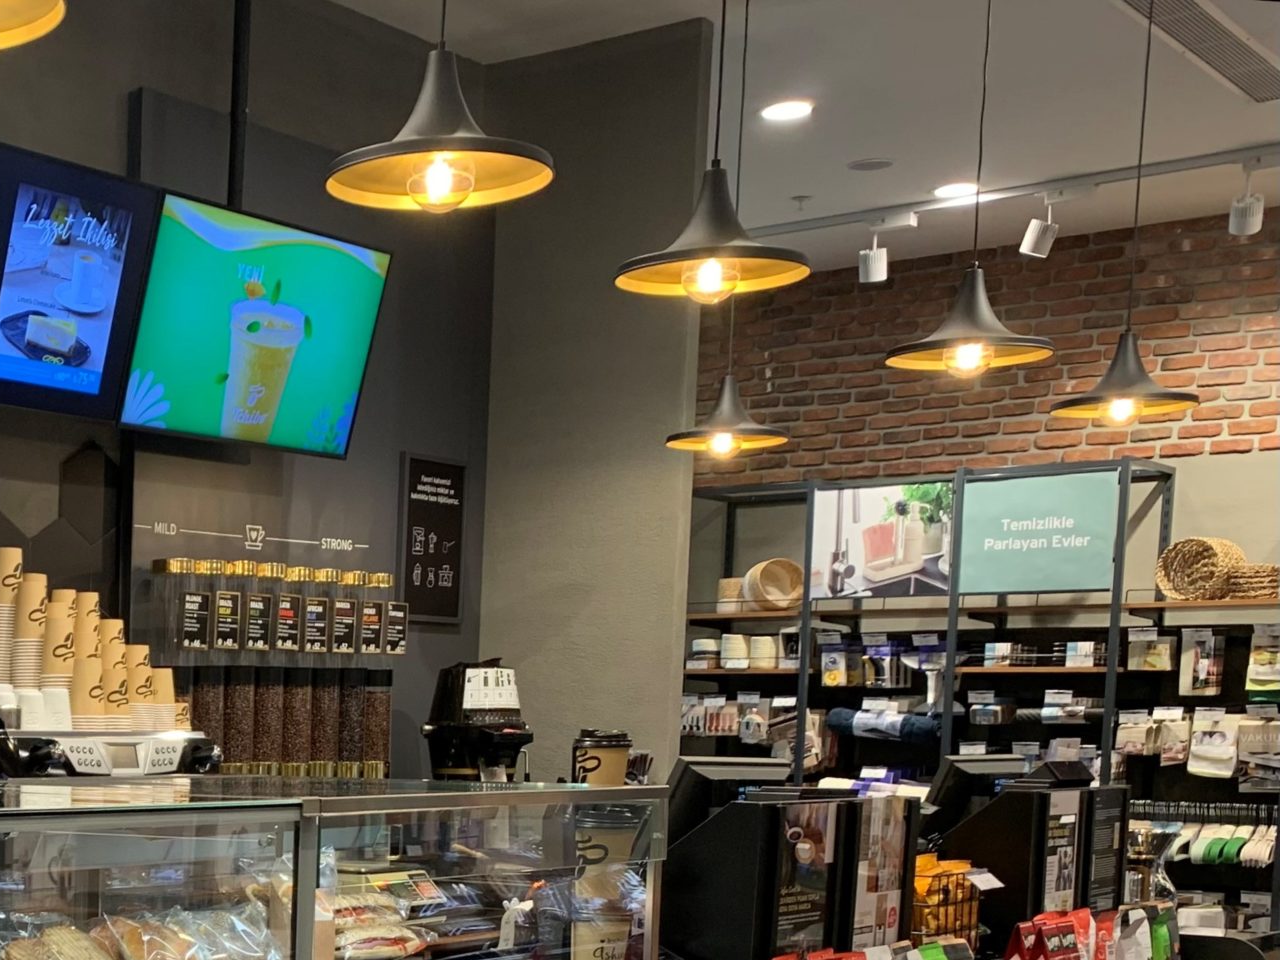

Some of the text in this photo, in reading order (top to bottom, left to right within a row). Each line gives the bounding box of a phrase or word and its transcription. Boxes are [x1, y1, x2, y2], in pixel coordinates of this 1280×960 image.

[22, 203, 76, 246] Lezzet
[236, 262, 264, 282] YENİ
[154, 521, 177, 536] MILD
[1001, 515, 1075, 532] Temizlikle
[321, 537, 353, 551] STRONG
[984, 534, 1091, 552] Parlayan Evler
